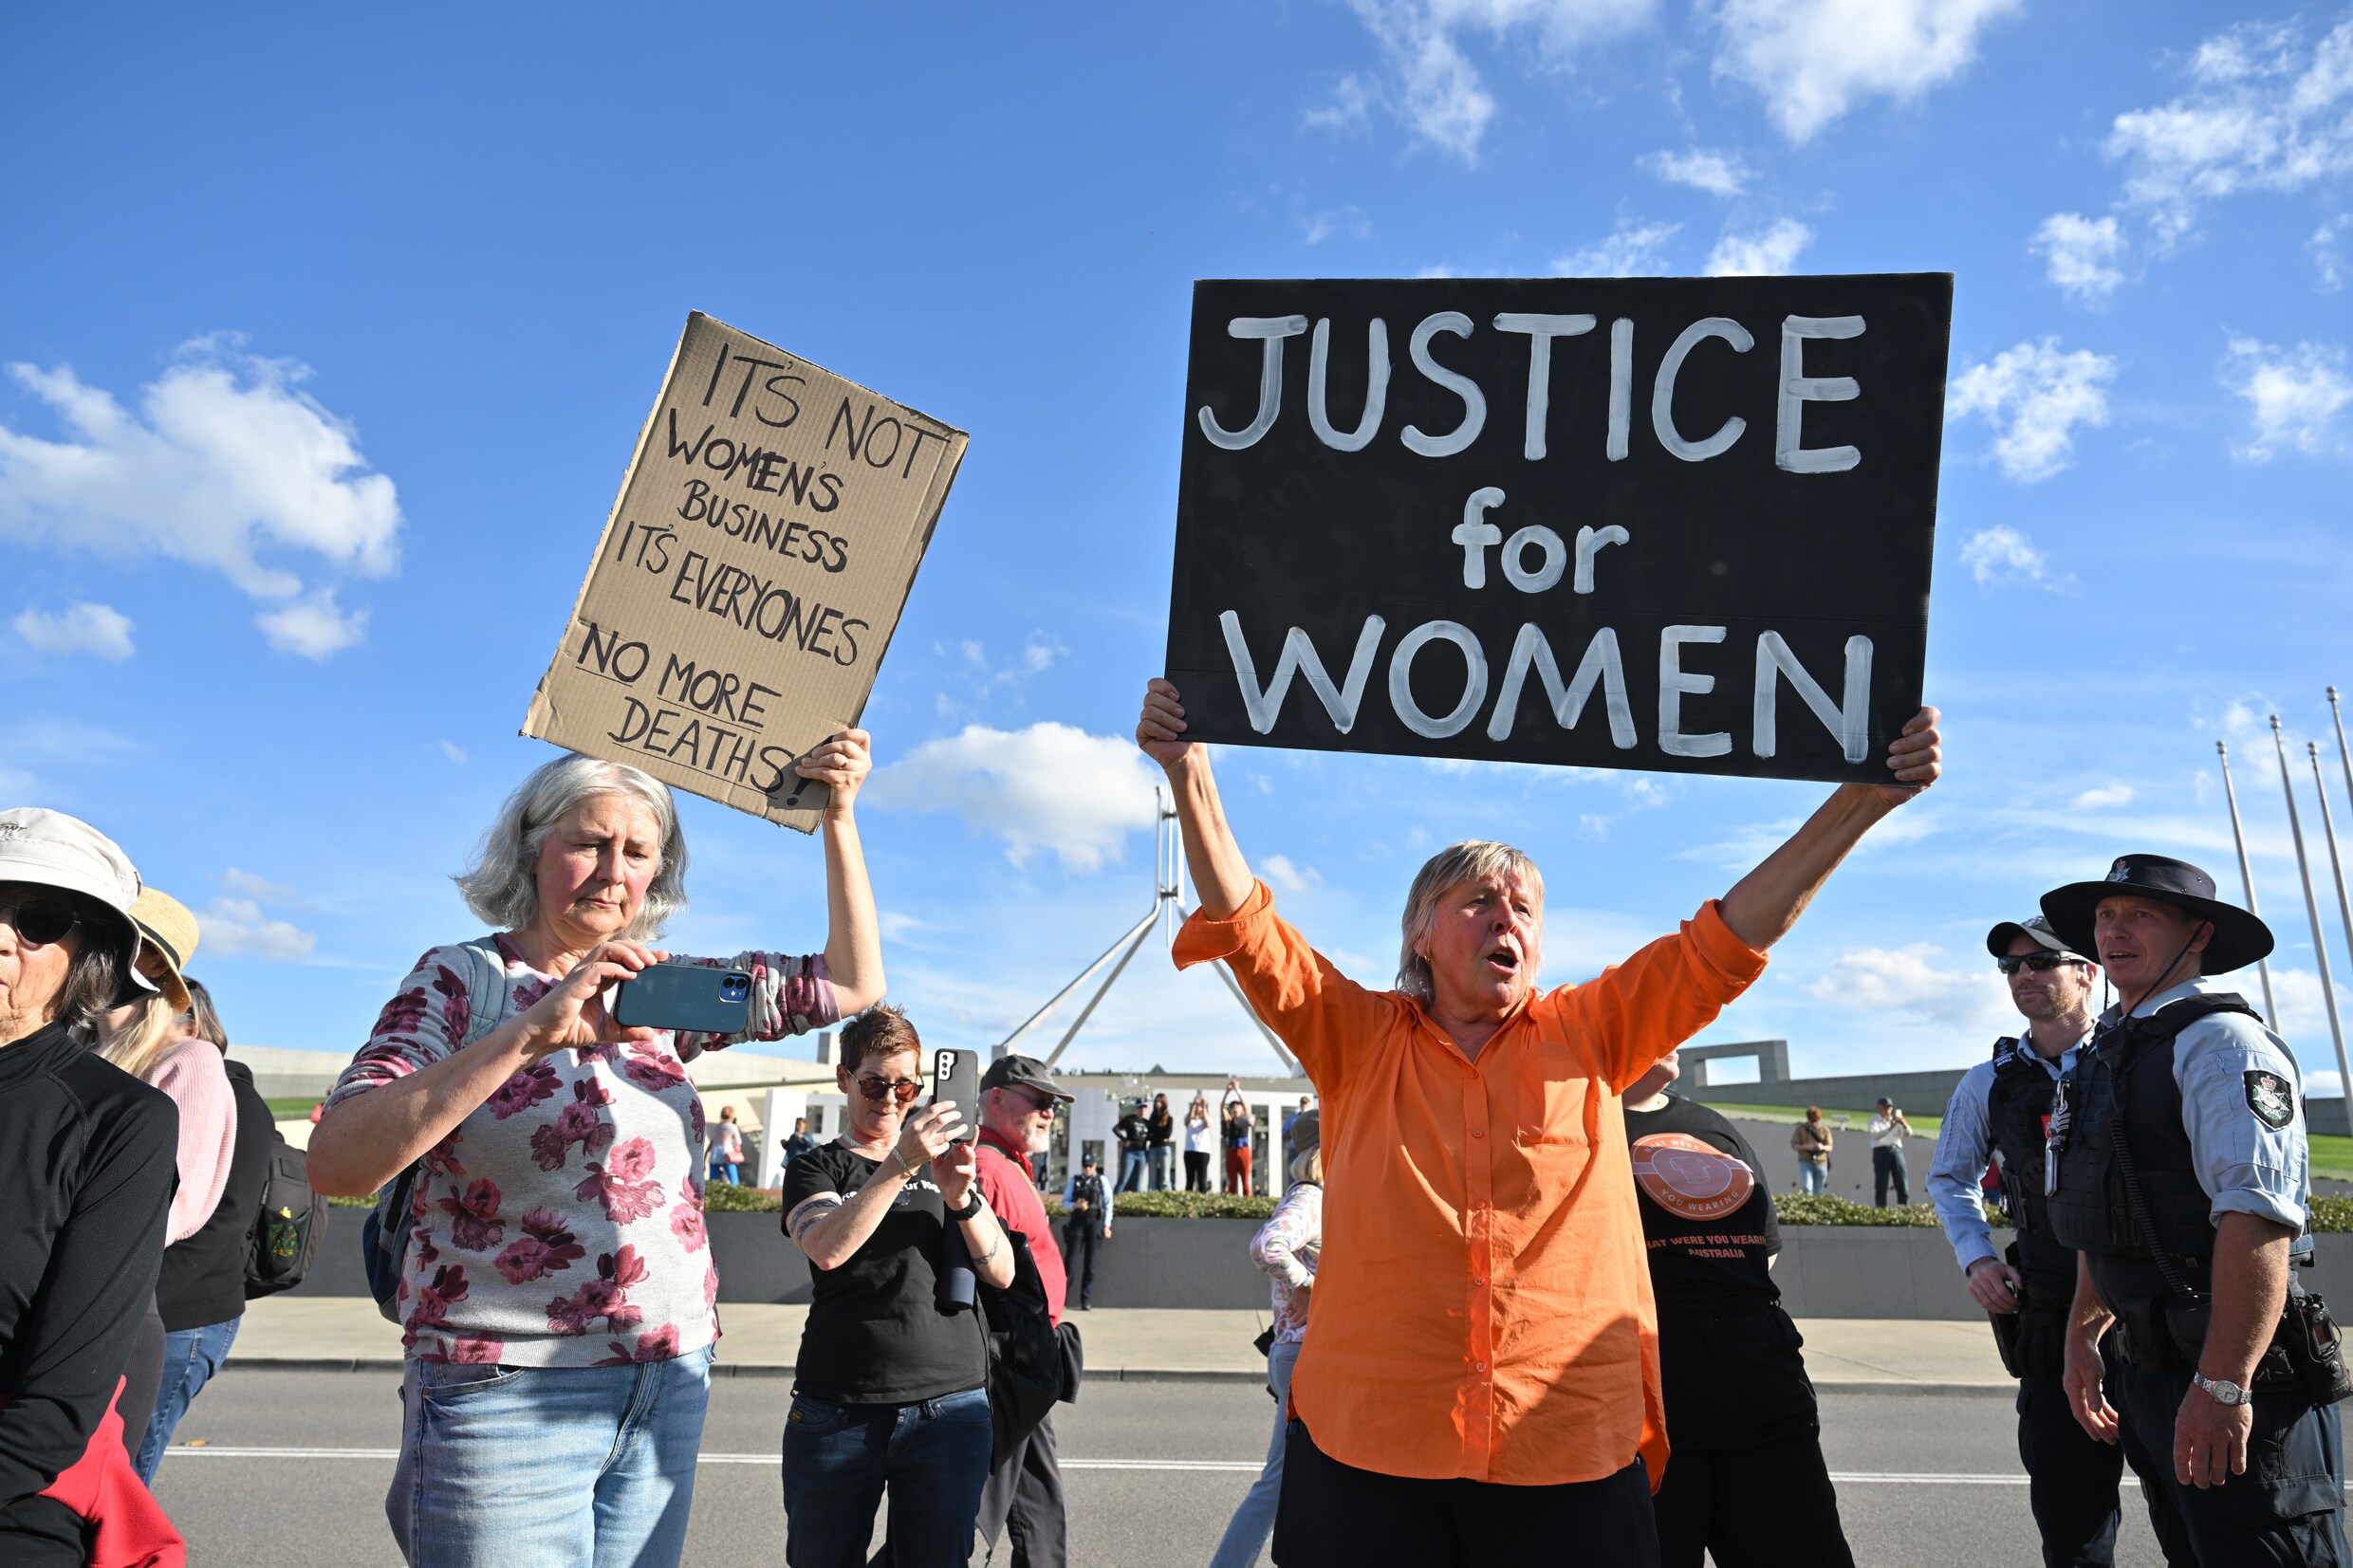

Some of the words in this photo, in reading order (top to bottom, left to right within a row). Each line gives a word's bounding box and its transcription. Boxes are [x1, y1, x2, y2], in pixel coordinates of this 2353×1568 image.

[702, 342, 806, 428] IT'S
[824, 396, 951, 478] NOT
[1197, 311, 1867, 474] JUSTICE
[667, 408, 843, 512] WOMEN'S
[677, 478, 848, 573] BUSINESS
[1451, 486, 1630, 594] for
[616, 520, 677, 575] IT'S
[670, 550, 869, 666] EVERYONES
[577, 622, 649, 683] NO
[657, 653, 782, 728] MORE
[1218, 609, 1874, 765] WOMEN
[608, 695, 835, 806] DEATHS!
[1646, 1238, 1667, 1250] HAT
[1669, 1235, 1705, 1245] WERE
[1706, 1235, 1729, 1245] YOU
[1730, 1235, 1767, 1245] WEARIN
[1660, 1190, 1684, 1207] YOU
[1689, 1190, 1738, 1211] WEARING
[1689, 1248, 1745, 1259] AUSTRALIA
